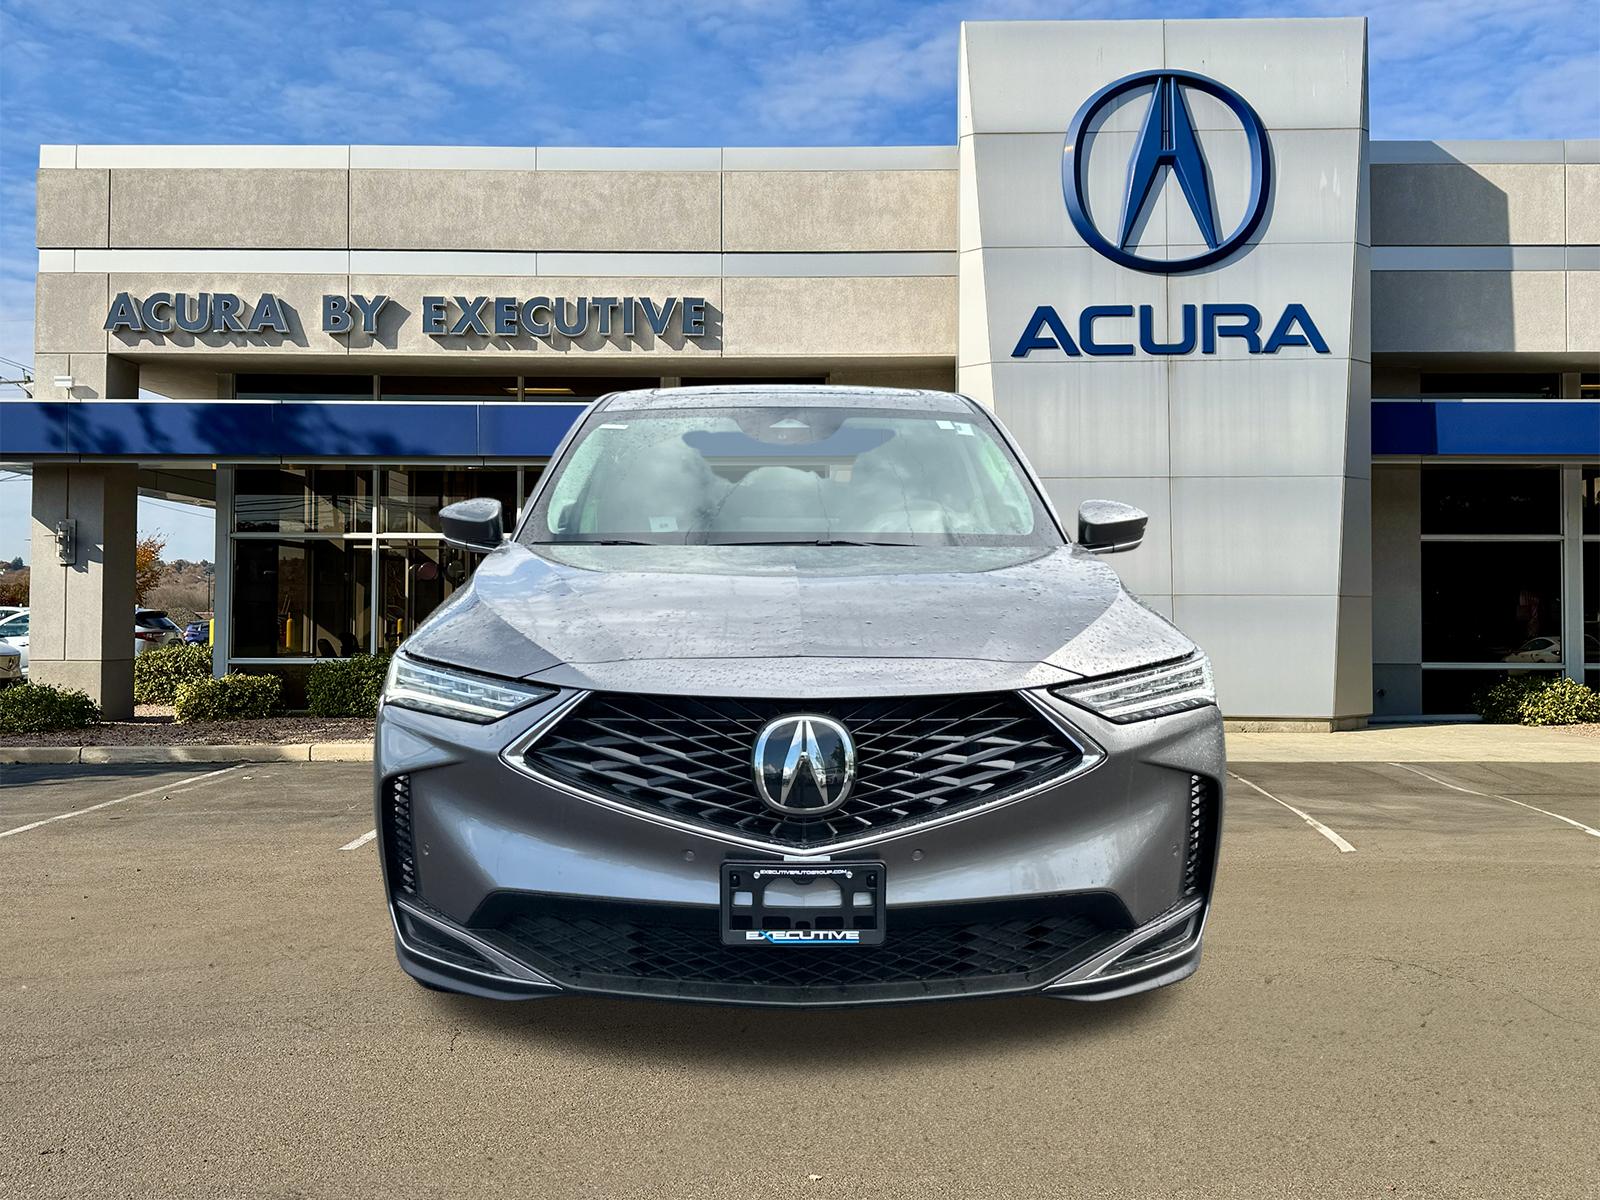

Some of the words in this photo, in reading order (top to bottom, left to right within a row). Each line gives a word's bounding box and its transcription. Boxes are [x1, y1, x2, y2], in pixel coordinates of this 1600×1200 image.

[103, 292, 290, 333] ACURA
[322, 294, 390, 335] BY
[422, 296, 706, 337] EXECUTIVE
[1010, 303, 1332, 357] ACURA
[745, 930, 860, 942] EXECUTIVE
